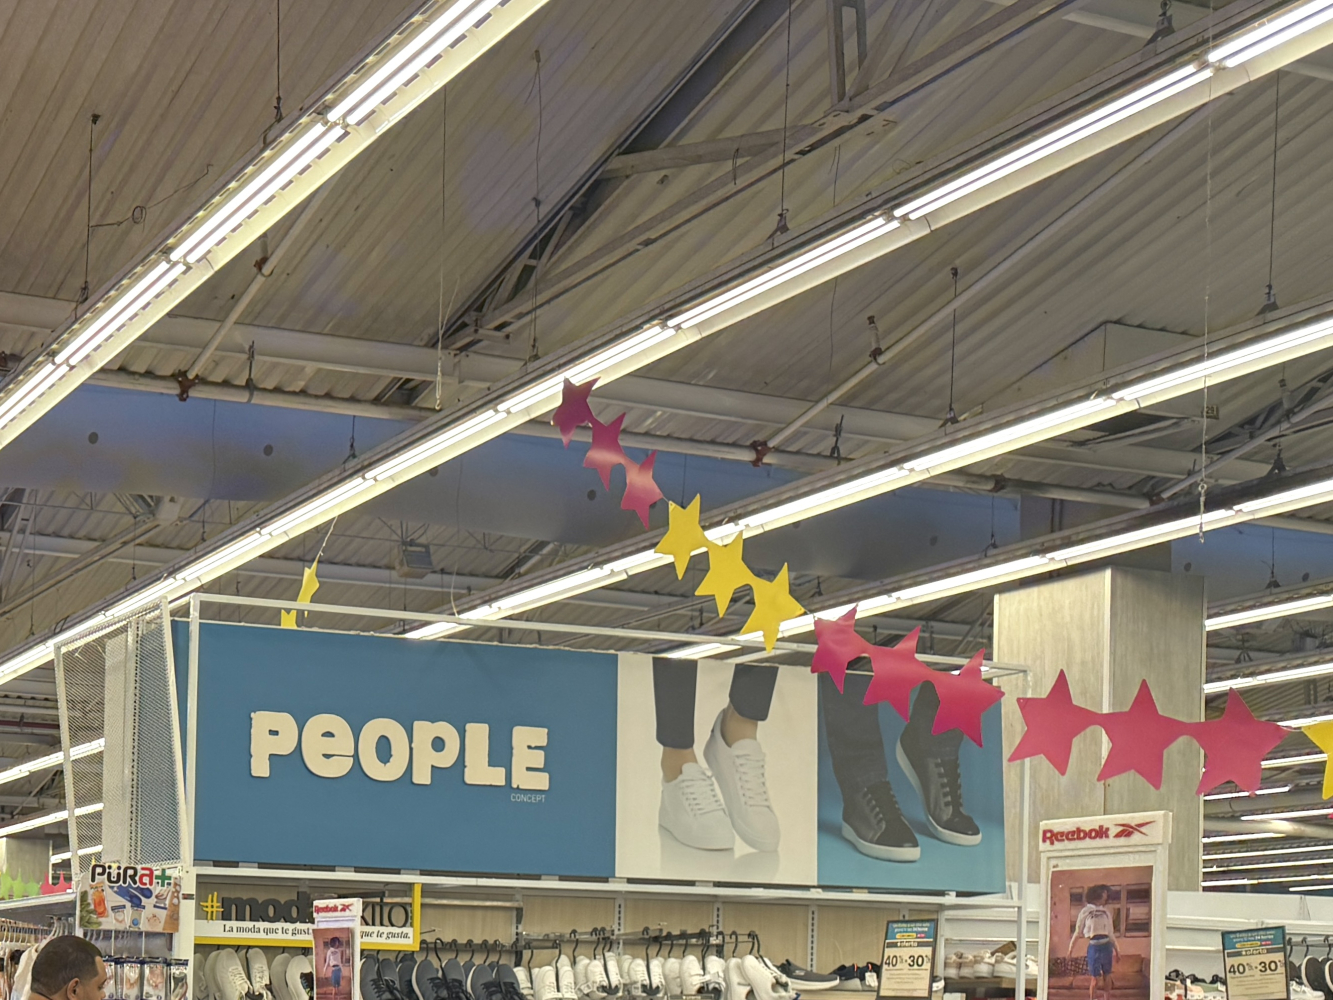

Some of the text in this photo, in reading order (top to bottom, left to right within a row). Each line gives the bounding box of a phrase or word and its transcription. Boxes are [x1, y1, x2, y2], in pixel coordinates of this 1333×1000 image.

[510, 793, 546, 803] CONCEPT
[1042, 825, 1110, 846] Reebok
[223, 924, 234, 933] La
[235, 924, 262, 934] moda
[263, 927, 280, 937] que
[281, 926, 290, 936] te
[291, 926, 312, 937] gust
[386, 930, 411, 942] gusta.
